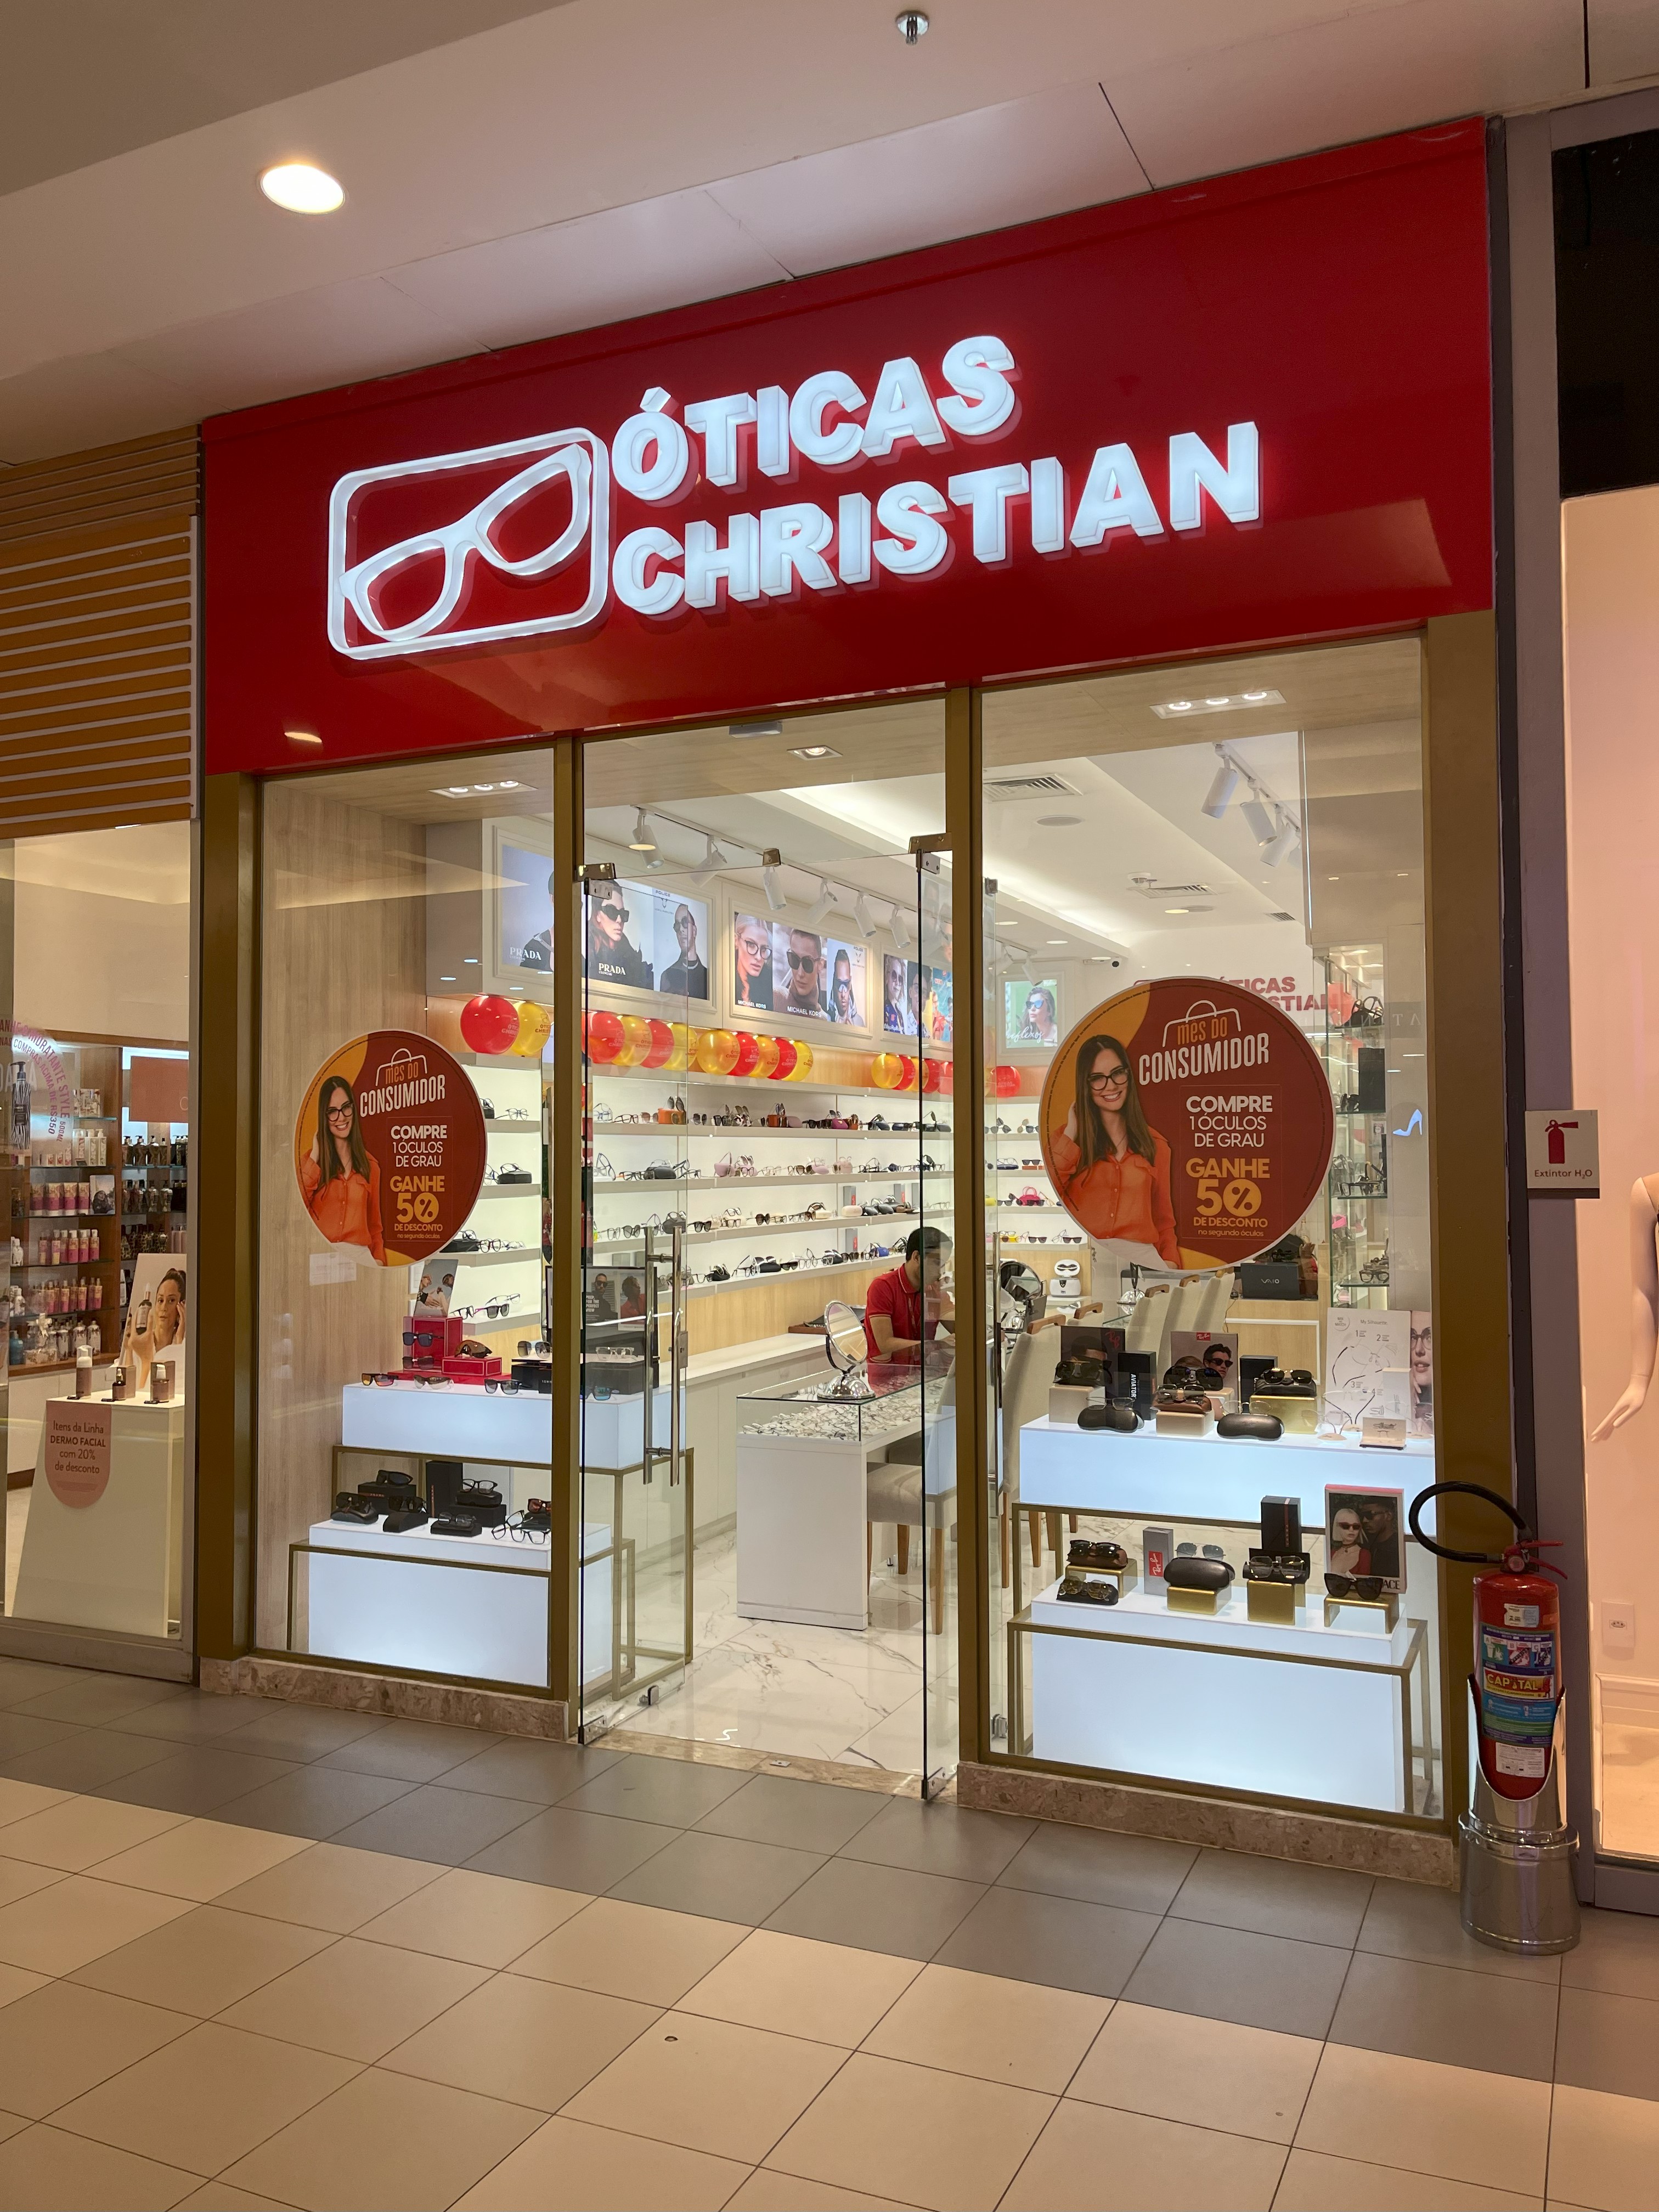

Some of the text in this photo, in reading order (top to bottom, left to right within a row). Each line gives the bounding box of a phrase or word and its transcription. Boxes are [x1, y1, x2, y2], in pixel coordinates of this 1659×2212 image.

[612, 335, 1015, 500] ÓTICAS
[613, 421, 1259, 615] CHRISTIAN
[510, 947, 541, 961] PRADA
[599, 963, 626, 975] PRADA
[738, 1000, 755, 1008] MICHAEL
[787, 1006, 808, 1015] MICHAEL
[1211, 1017, 1228, 1038] DO
[1139, 1032, 1269, 1085] CONSUMIDOR
[0, 1019, 21, 1034] ANHE
[58, 1085, 70, 1118] STYLE
[13, 1039, 42, 1065] COMPRAS
[40, 1064, 54, 1091] ACIMA
[49, 1092, 56, 1103] DE
[408, 1062, 419, 1079] DO
[360, 1074, 445, 1118] CONSUMIDOR
[1186, 1096, 1273, 1113] COMPRE
[1198, 1113, 1267, 1131] ÓCULOS
[391, 1125, 447, 1139] COMPRE
[398, 1138, 443, 1153] ÓCULOS
[1194, 1133, 1264, 1148] DE GRAU
[396, 1155, 442, 1167] DE GRAU
[1186, 1158, 1271, 1178] GANHE
[390, 1176, 445, 1192] GANHE
[1194, 1217, 1268, 1228] DE DESCONTO
[1208, 1229, 1239, 1238] segundo
[53, 1420, 104, 1434] Itens da Linha
[50, 1435, 106, 1447] DERMO FACIAL
[78, 1448, 95, 1460] 20%
[55, 1460, 99, 1474] de desconto
